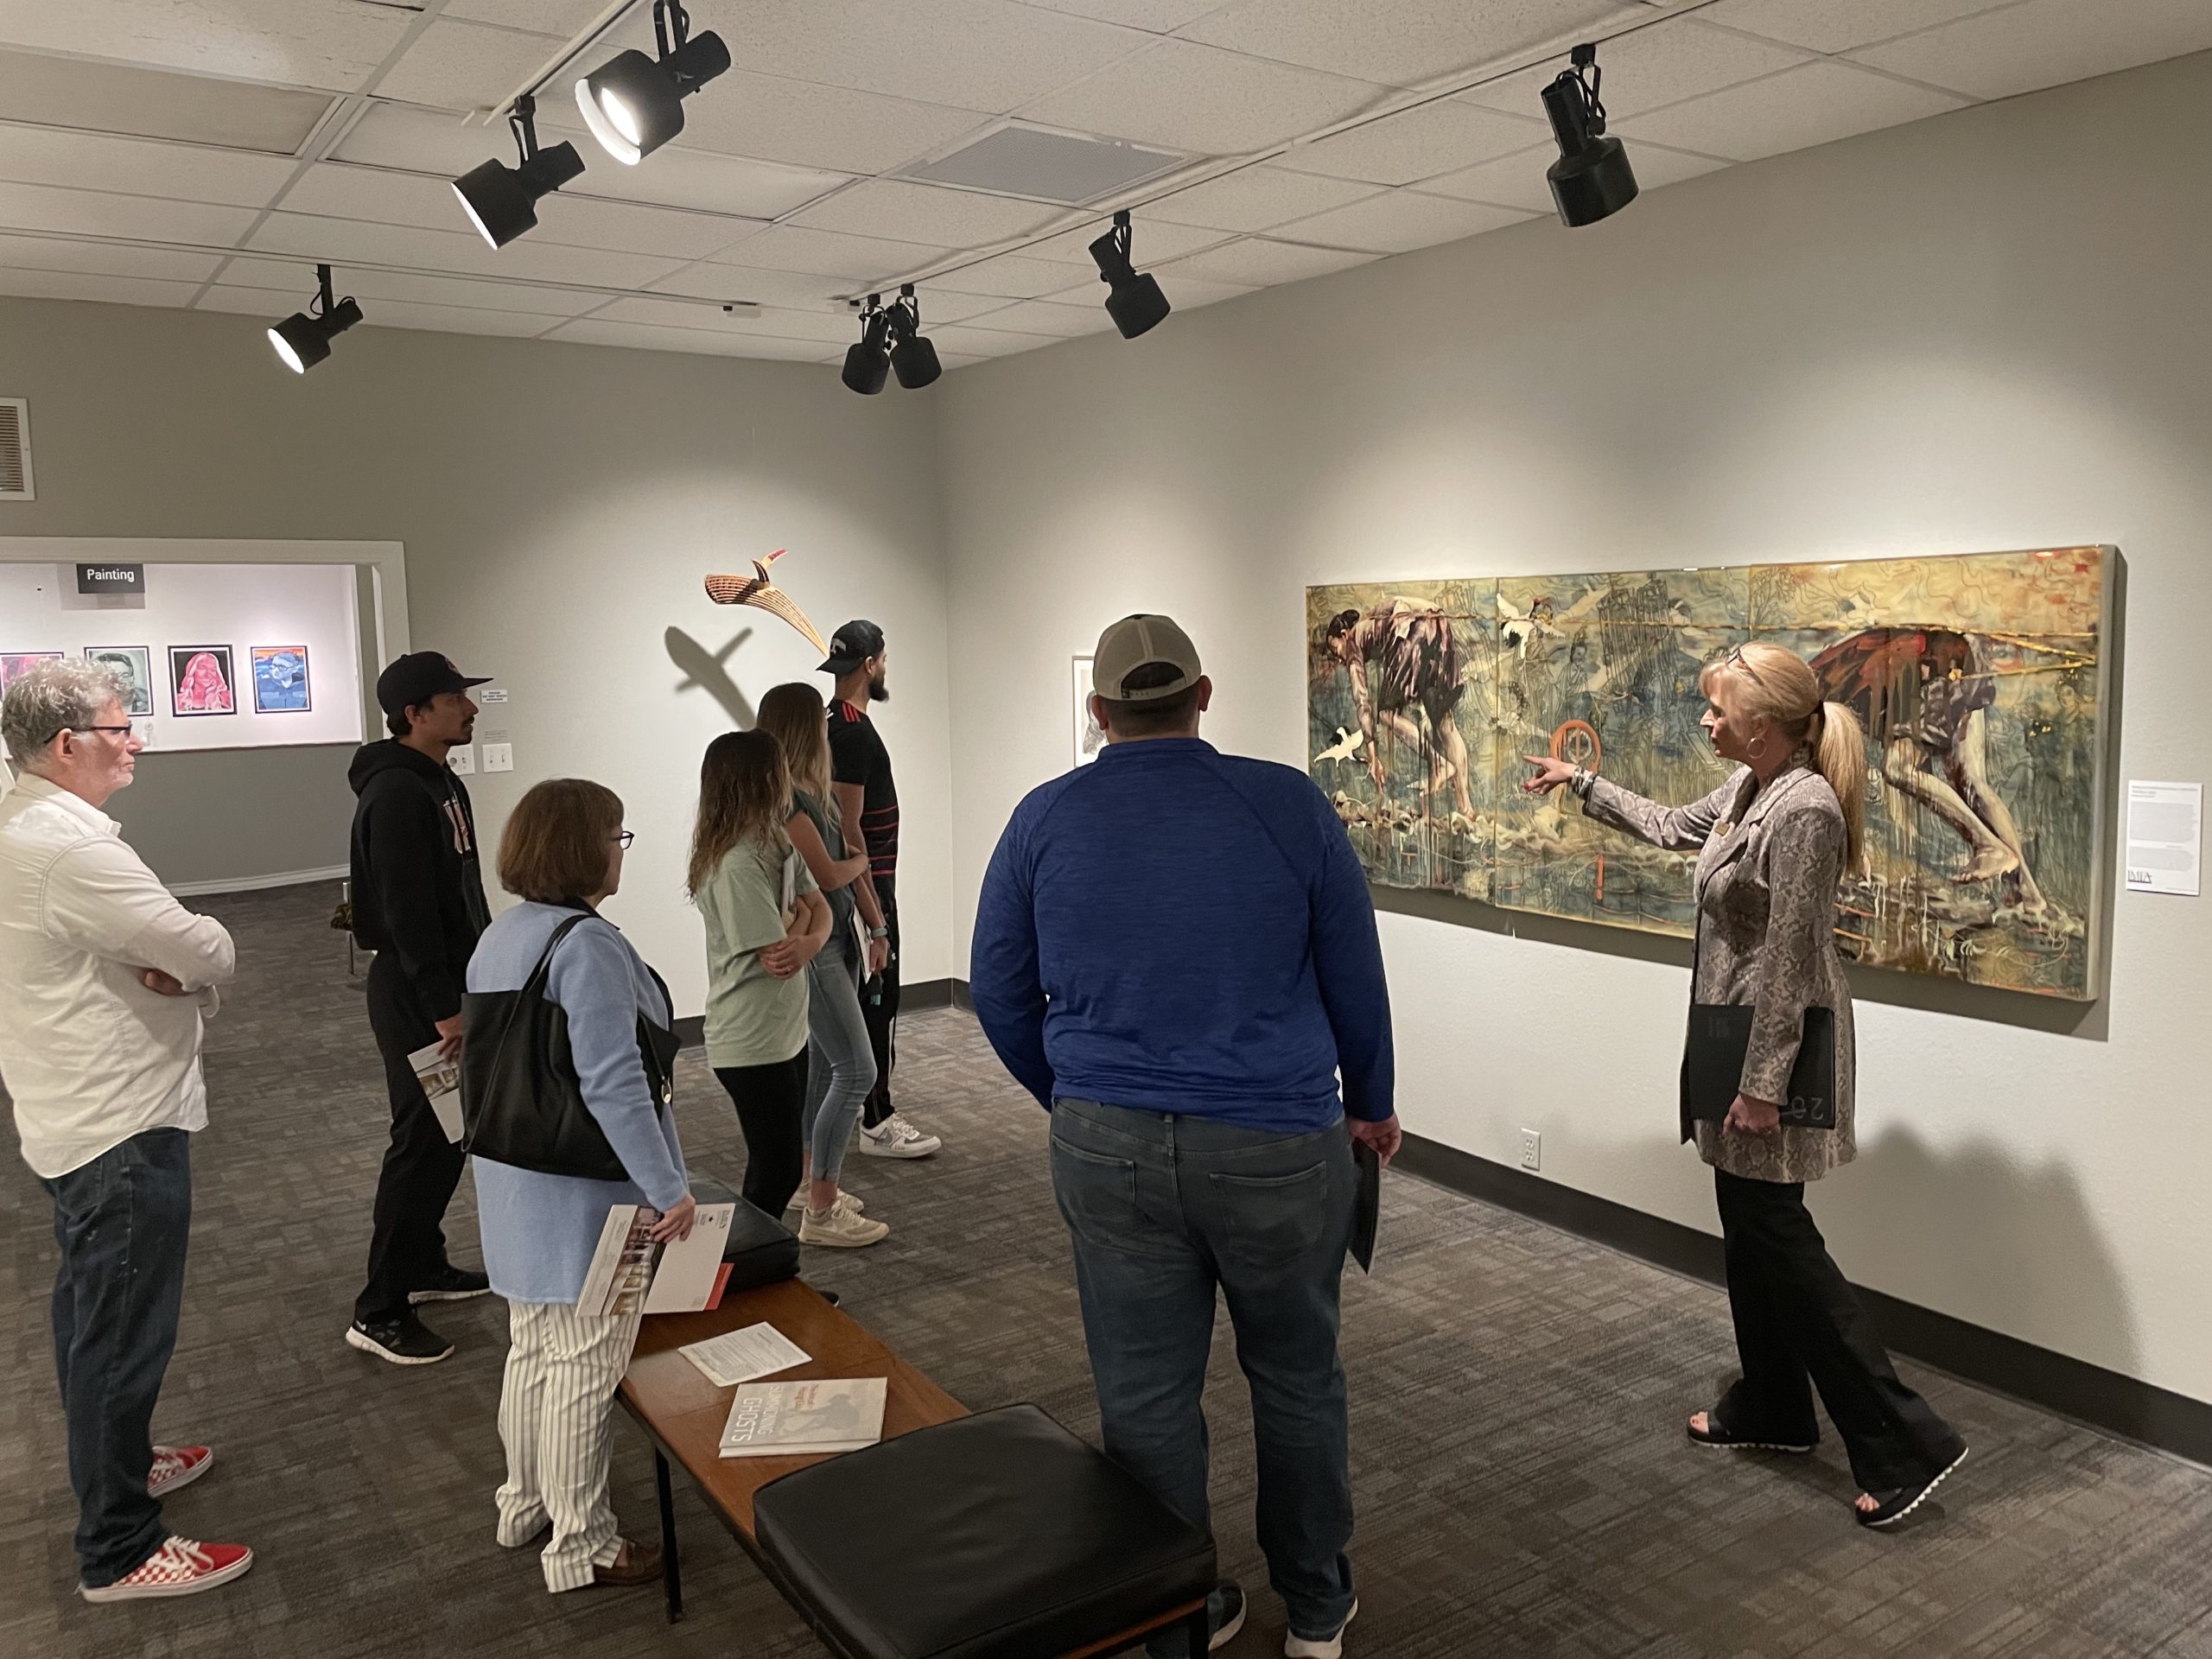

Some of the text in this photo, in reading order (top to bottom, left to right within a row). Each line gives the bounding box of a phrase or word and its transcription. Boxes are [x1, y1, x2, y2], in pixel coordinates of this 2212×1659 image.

[86, 569, 135, 582] Painting
[731, 1397, 762, 1442] GHOSTS
[757, 1385, 784, 1435] SUMMONING
